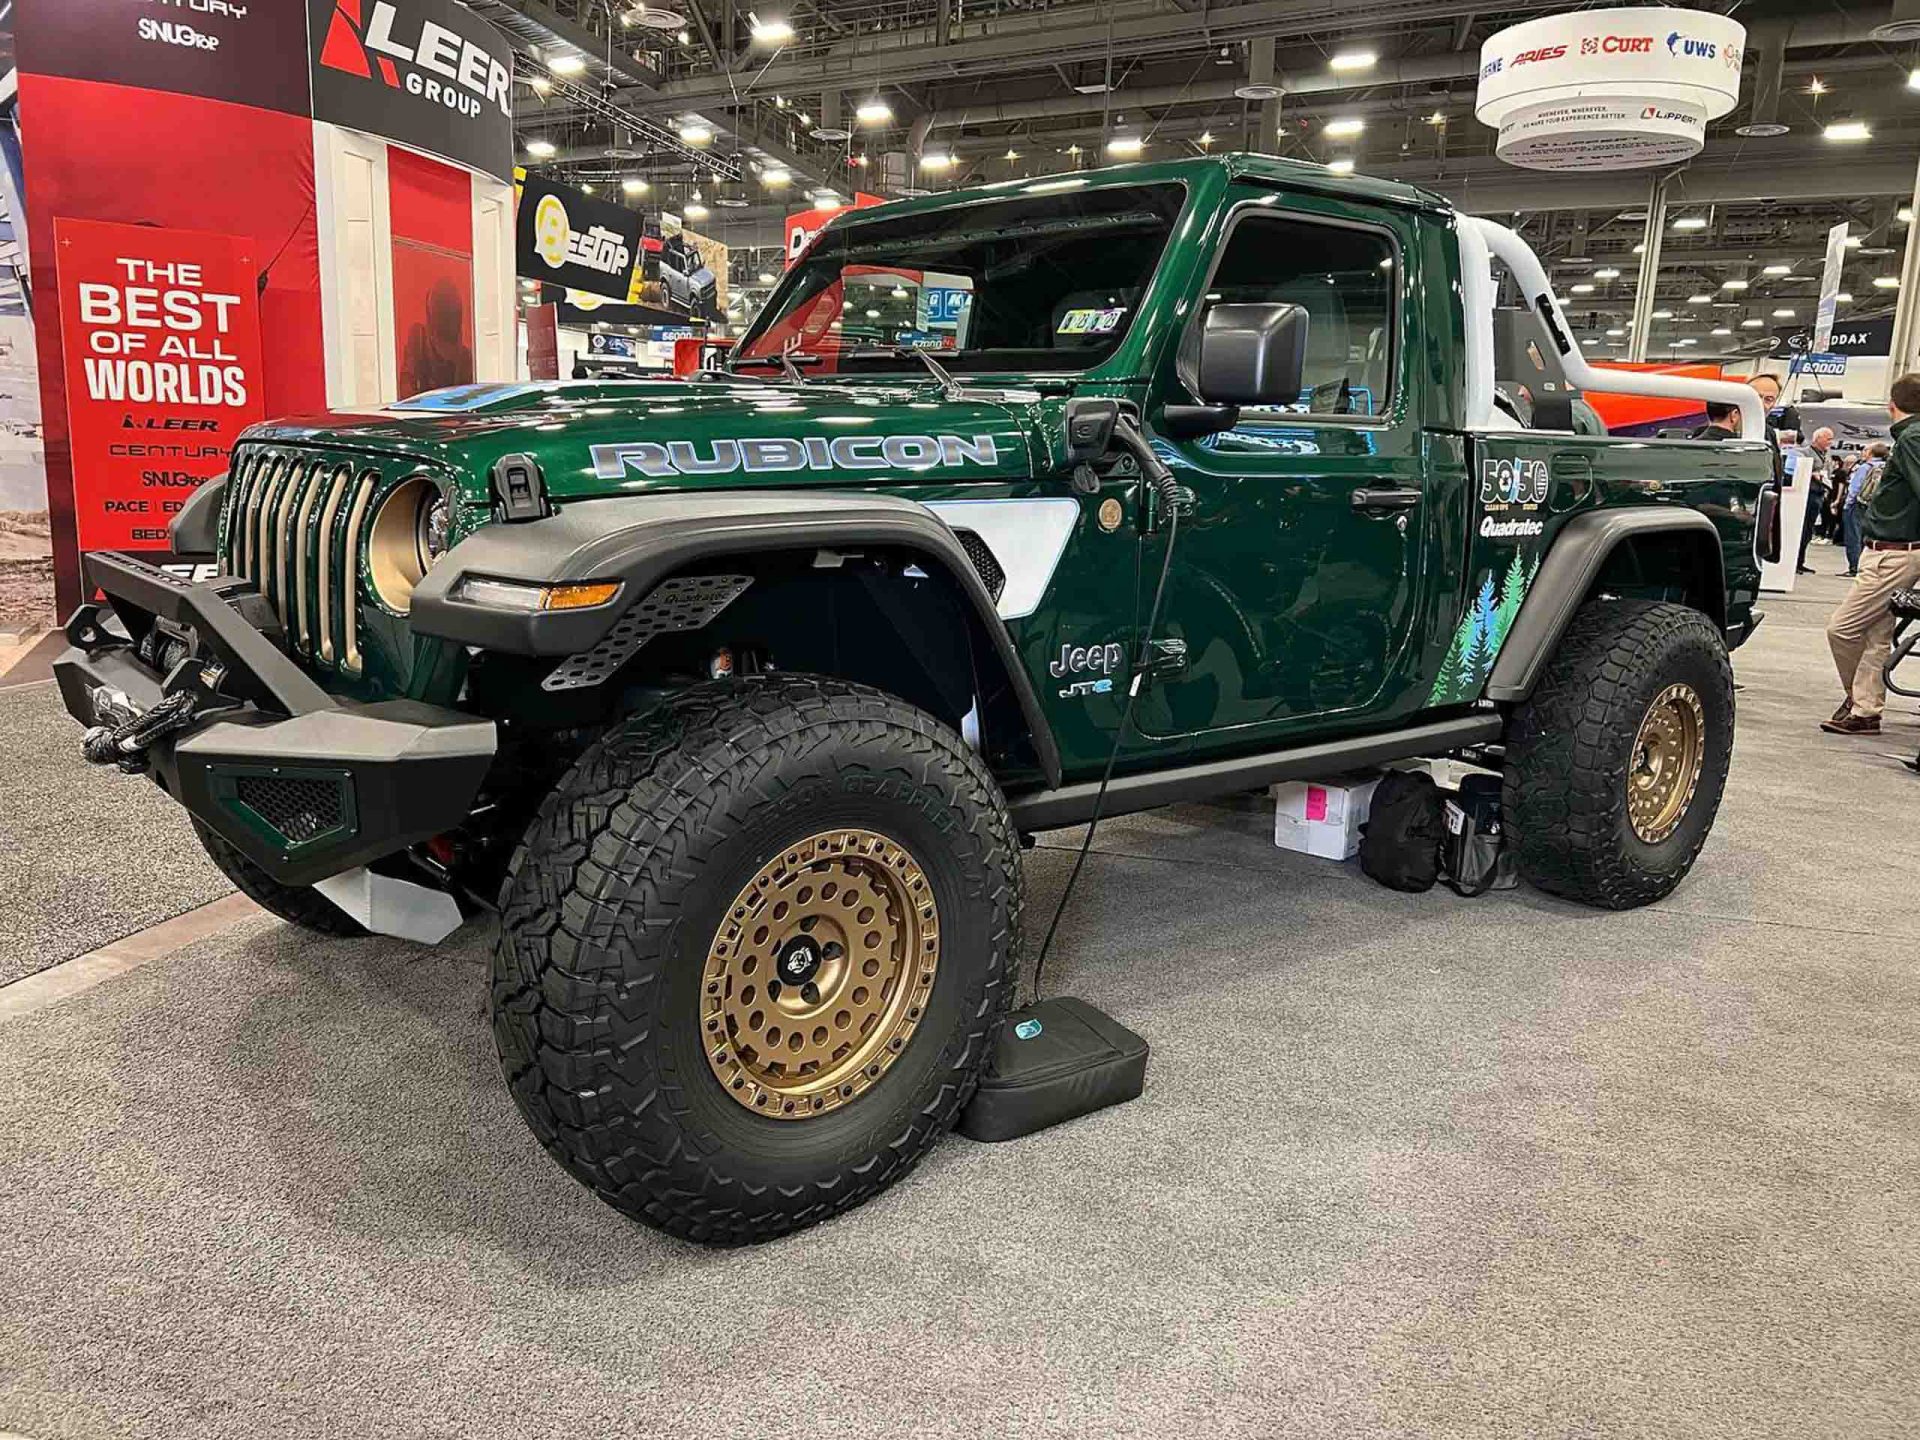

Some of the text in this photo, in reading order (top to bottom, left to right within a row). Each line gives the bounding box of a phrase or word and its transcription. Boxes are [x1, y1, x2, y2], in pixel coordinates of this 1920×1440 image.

[365, 1, 512, 118] LEER
[1510, 44, 1568, 68] ARIES
[1602, 36, 1653, 53] CURT
[1684, 40, 1716, 59] UWS
[406, 73, 481, 118] GROUP
[116, 257, 202, 287] THE
[79, 283, 240, 333] BEST
[89, 331, 237, 361] OF ALL
[84, 358, 246, 407] WORLDS
[146, 418, 219, 432] LEER
[589, 435, 998, 478] RUBICON
[1480, 457, 1549, 503] 50/50
[105, 501, 149, 513] PACE
[1480, 515, 1544, 538] Quadratec
[1050, 643, 1122, 678] Jeep
